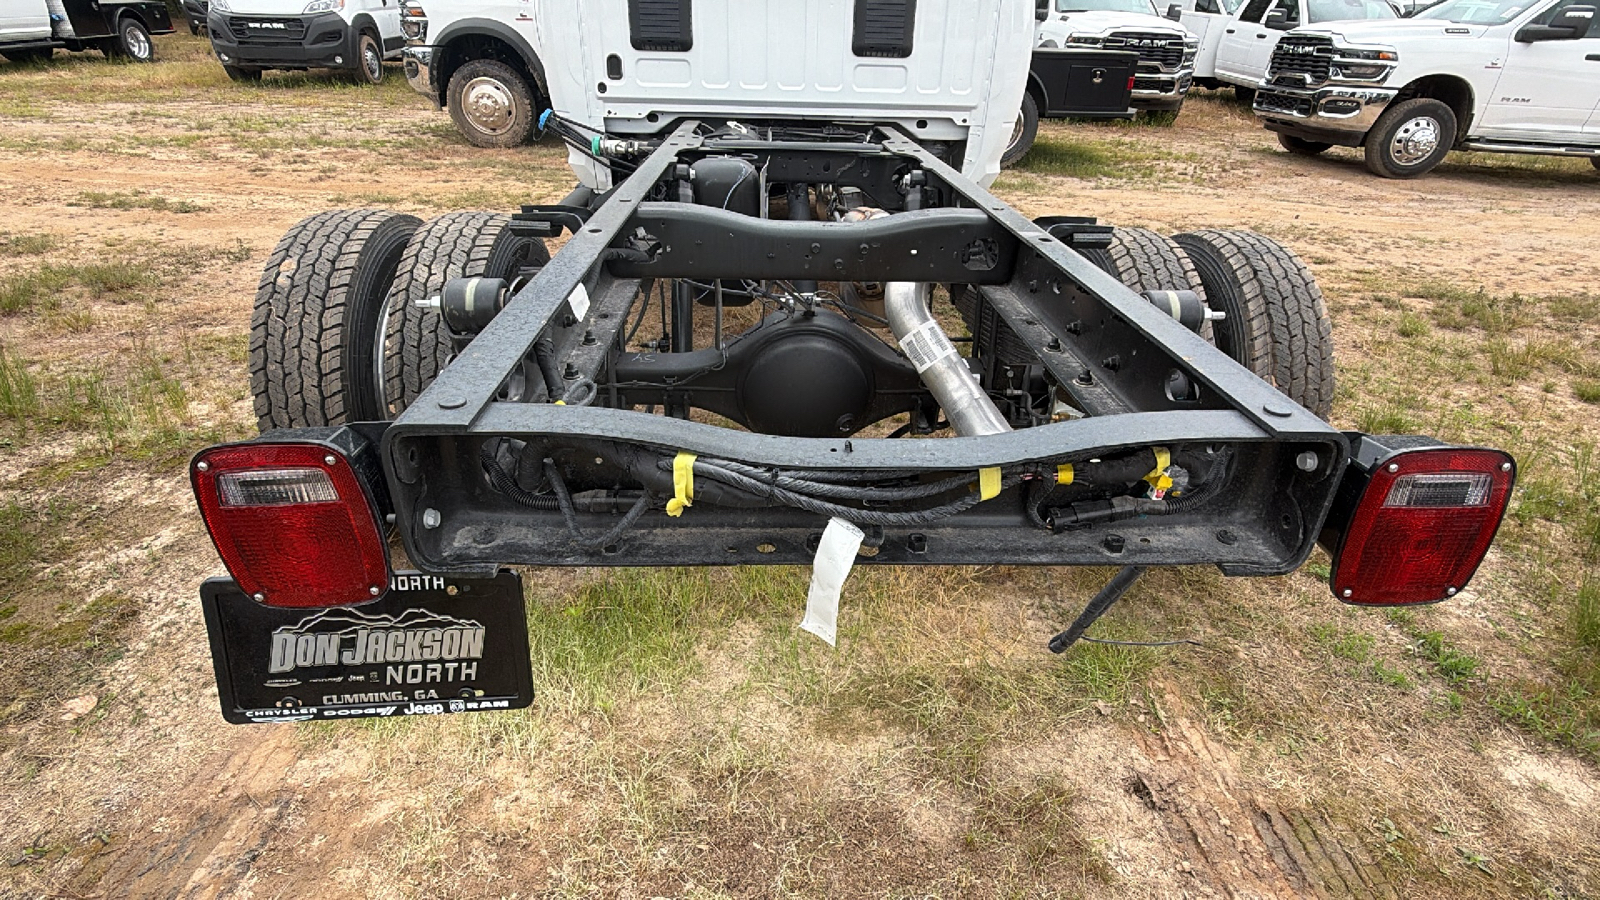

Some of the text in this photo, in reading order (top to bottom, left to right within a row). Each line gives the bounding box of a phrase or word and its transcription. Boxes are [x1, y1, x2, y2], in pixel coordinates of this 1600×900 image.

[1126, 38, 1167, 48] RAM
[268, 626, 486, 674] DON JACKSON
[386, 662, 478, 686] NORTH
[322, 689, 439, 706] CUMMING, GA
[245, 700, 509, 718] CHRYSLER DODGE Jeep RAM
